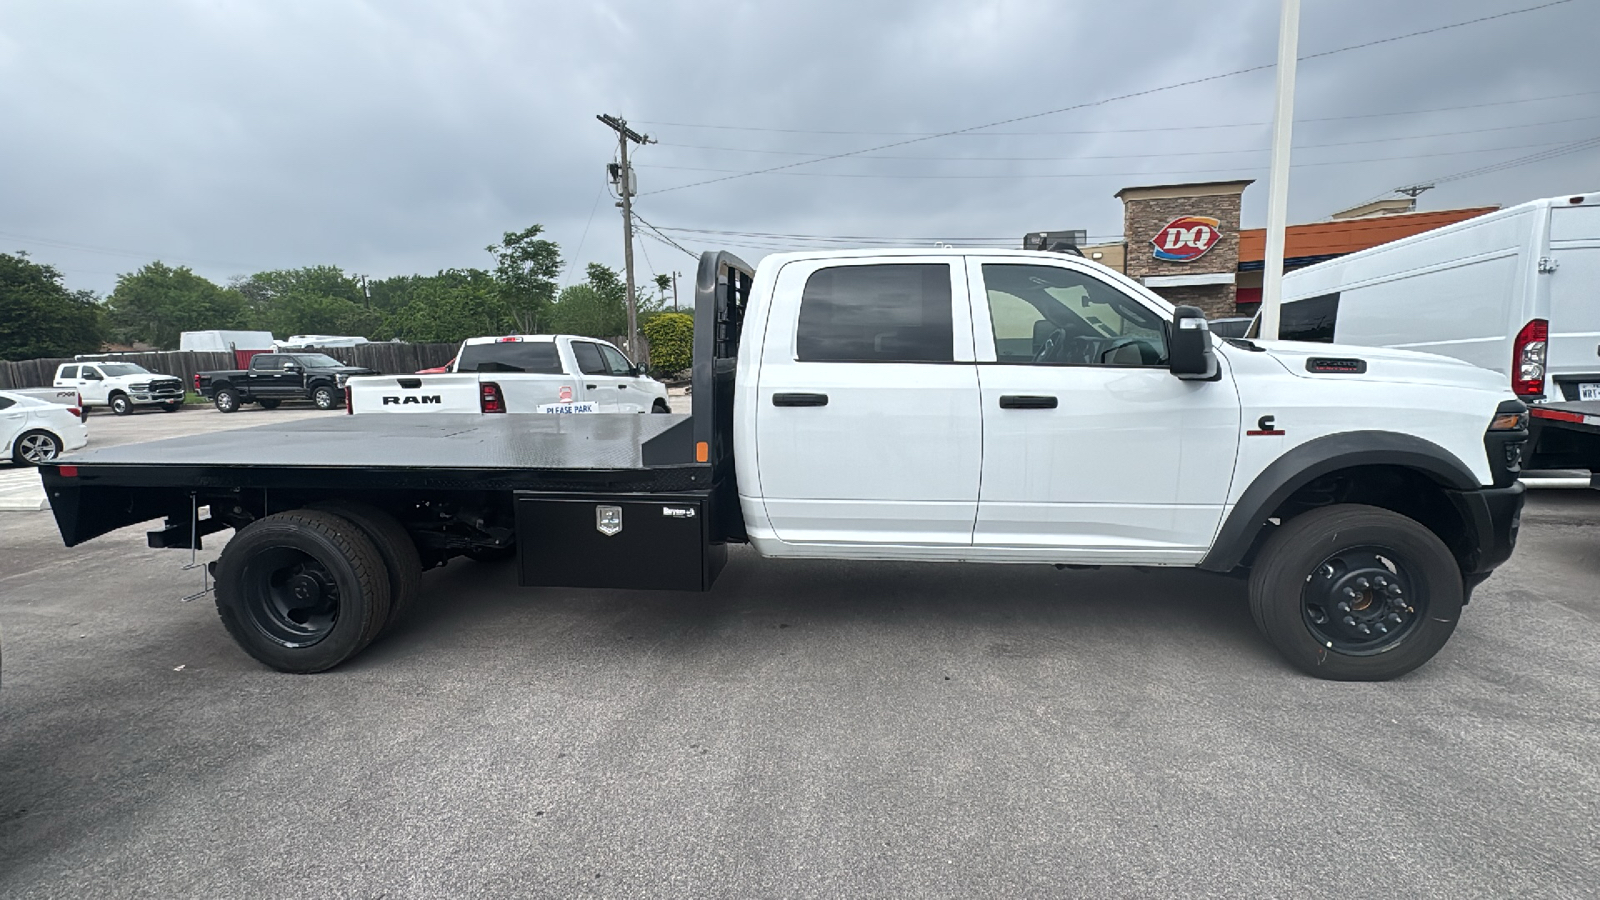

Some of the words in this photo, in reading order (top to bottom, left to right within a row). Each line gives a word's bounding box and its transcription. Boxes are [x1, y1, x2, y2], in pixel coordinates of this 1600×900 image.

[1163, 225, 1208, 250] DQ
[382, 395, 442, 405] RAM
[546, 406, 573, 414] PLEASE
[574, 404, 592, 413] PARK
